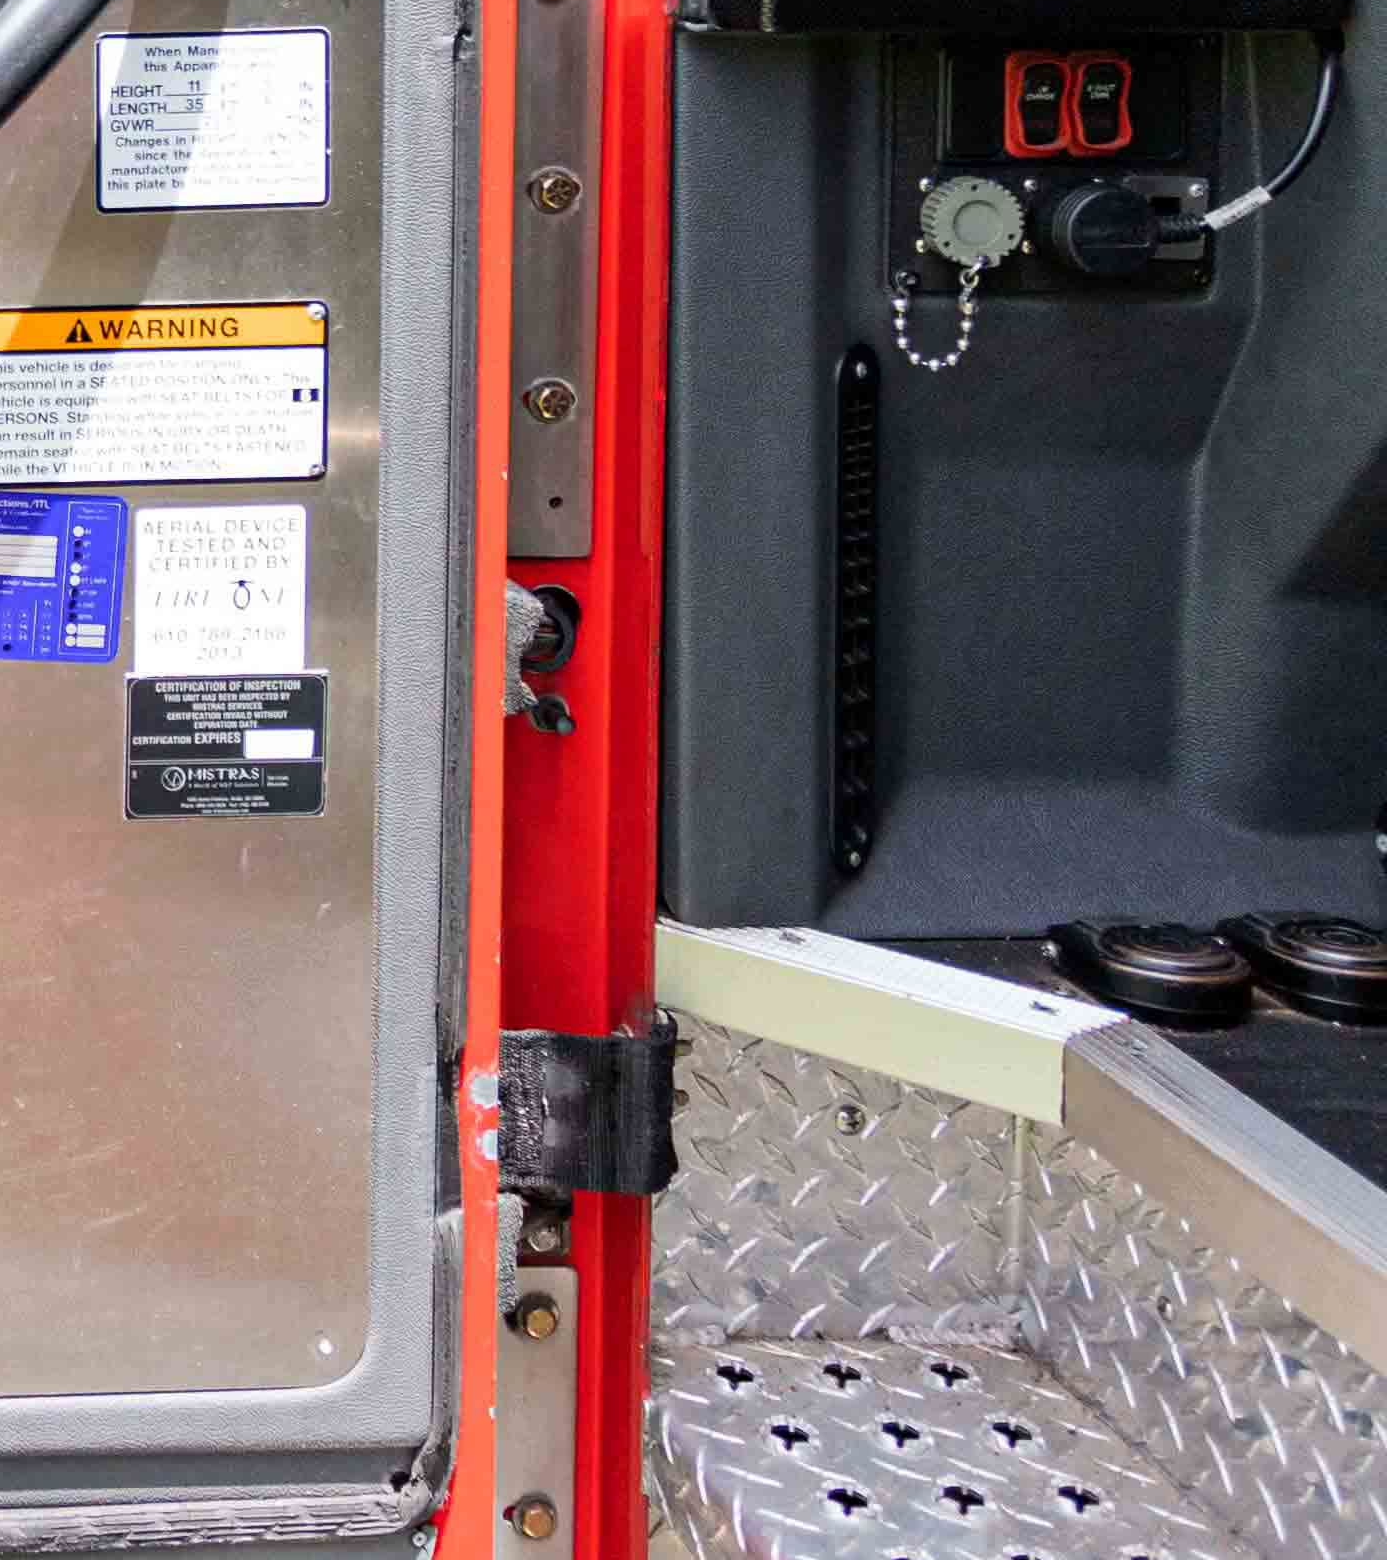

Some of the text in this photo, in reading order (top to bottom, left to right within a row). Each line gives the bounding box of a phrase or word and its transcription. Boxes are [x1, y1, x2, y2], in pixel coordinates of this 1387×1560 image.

[144, 47, 182, 57] When
[144, 61, 168, 72] this
[110, 85, 164, 98] HEIGHT
[110, 99, 204, 116] LENGTH 35
[110, 120, 155, 133] GVWR
[115, 135, 187, 148] Changes in
[134, 151, 168, 161] since
[107, 179, 168, 192] this plate
[99, 317, 240, 340] WARNING
[19, 361, 70, 373] vehicle
[74, 361, 85, 372] is
[60, 378, 73, 390] in
[39, 396, 51, 407] is
[15, 429, 55, 441] result
[59, 429, 72, 440] in
[26, 462, 49, 475] the
[143, 516, 299, 535] AERIAL DEVICE
[156, 536, 287, 553] TESTED AND
[148, 554, 292, 572] CERTIFIED BY
[155, 680, 301, 693] CERTIFICATION OF INSPECTION
[132, 732, 241, 745] CERTIFICATION EXPIRES
[187, 767, 260, 781] MISTRAS
